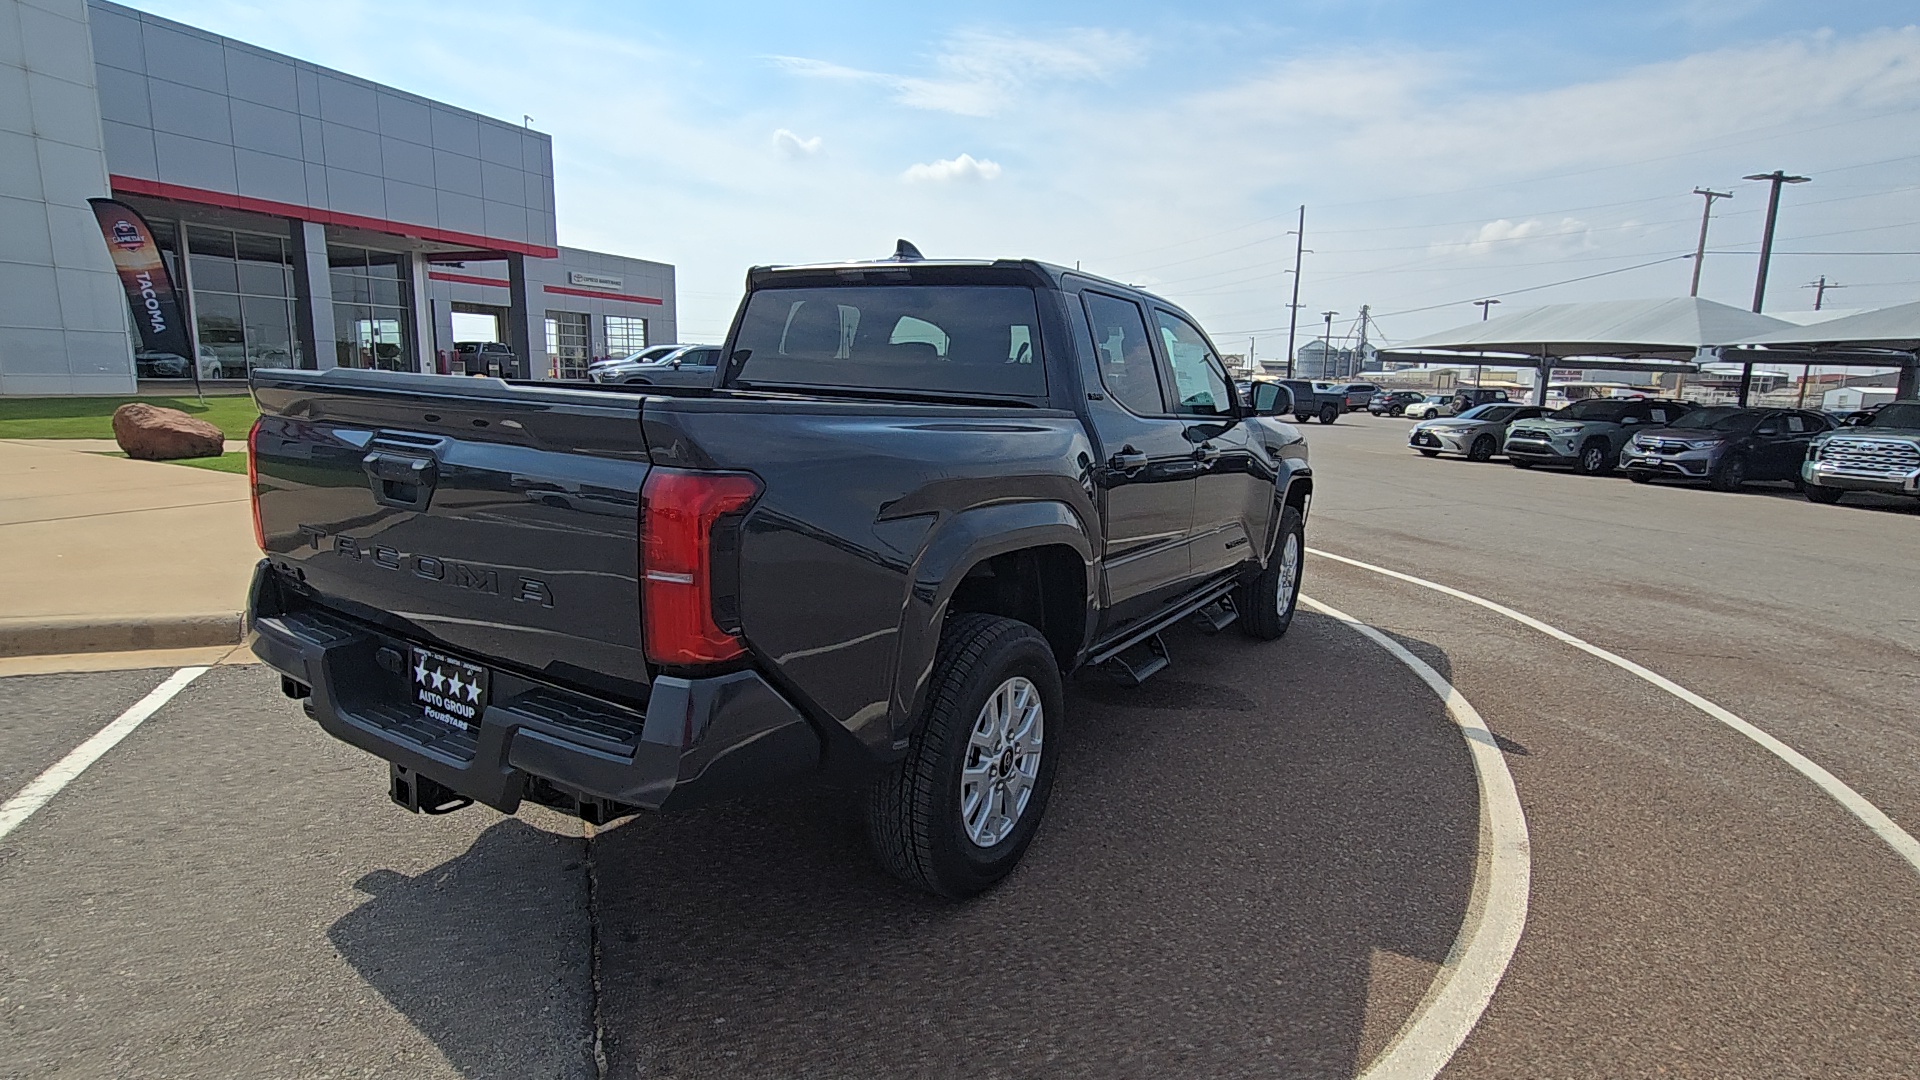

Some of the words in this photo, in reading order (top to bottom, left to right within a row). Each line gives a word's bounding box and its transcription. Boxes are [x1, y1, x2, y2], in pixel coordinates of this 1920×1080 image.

[135, 271, 167, 334] TACOMA
[299, 524, 555, 609] TACOMA
[419, 688, 443, 708] AUTO
[443, 697, 476, 719] GROUP
